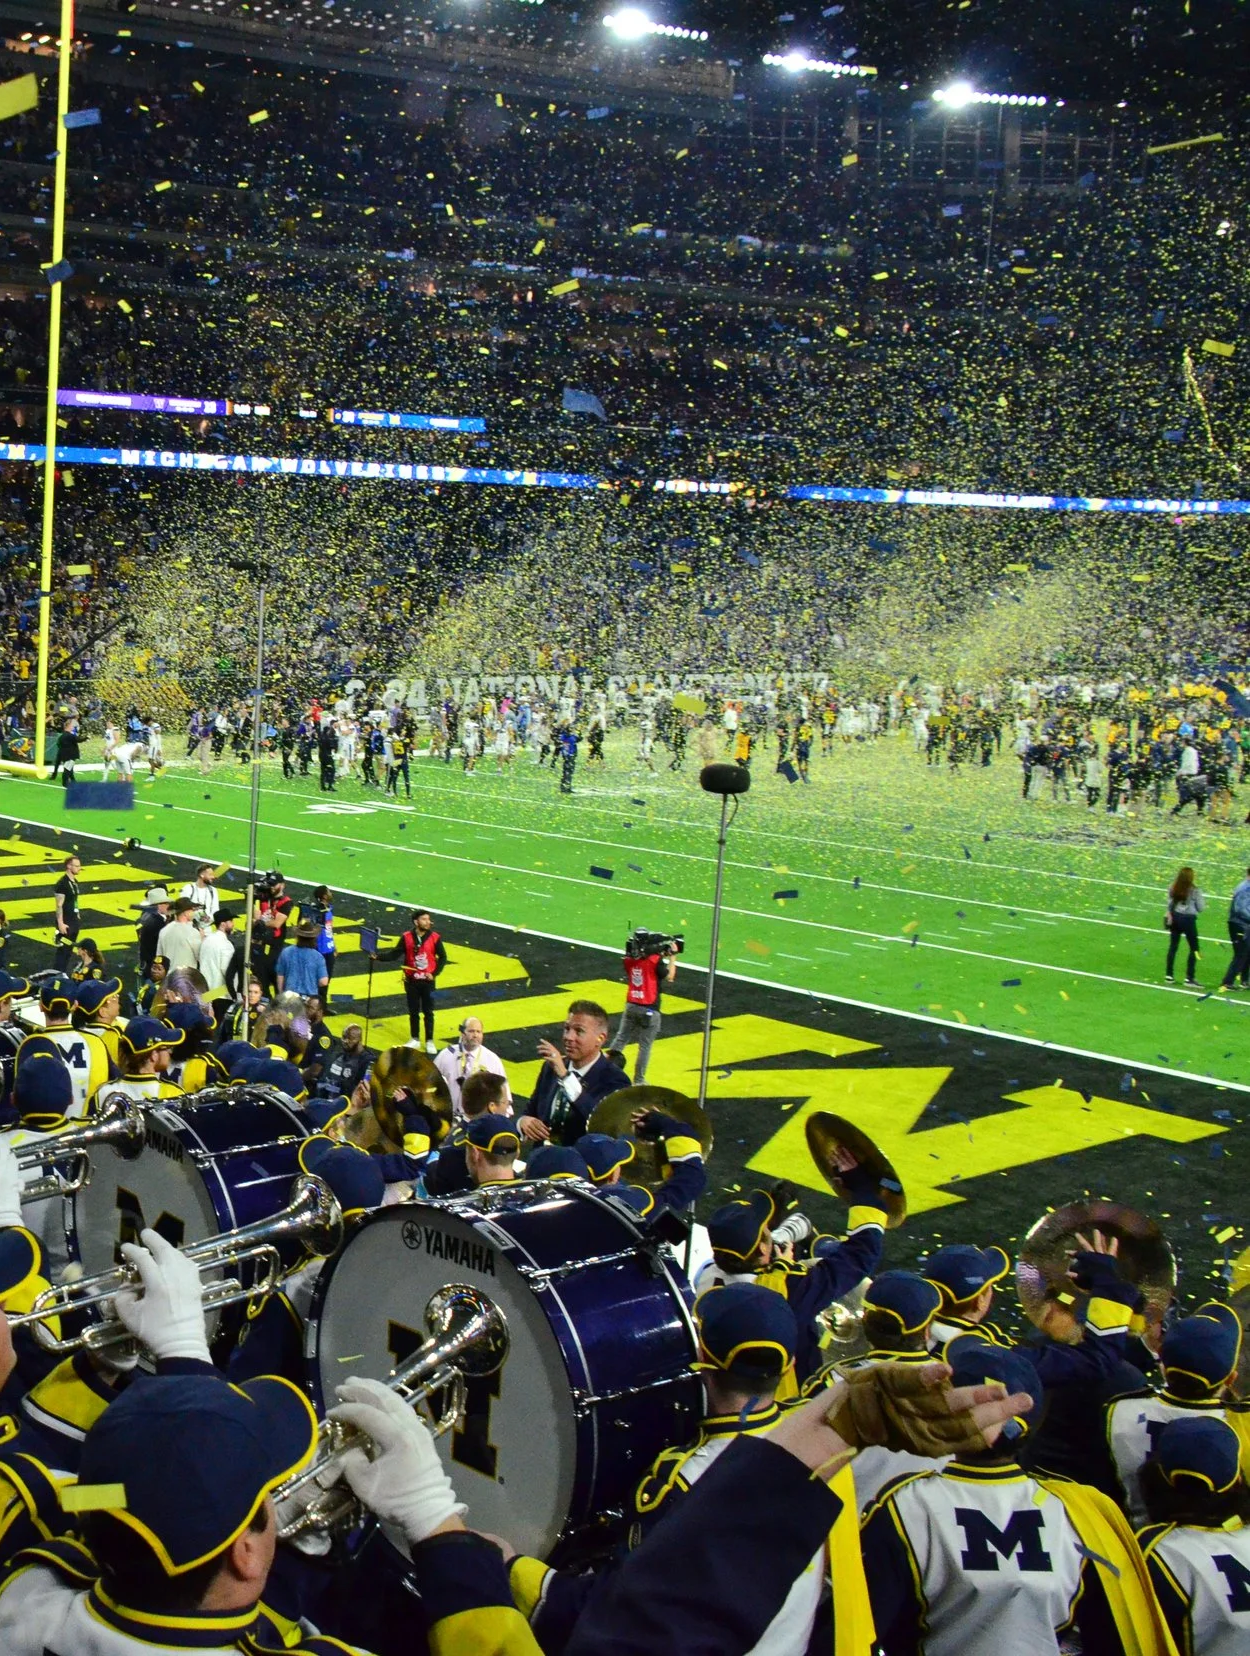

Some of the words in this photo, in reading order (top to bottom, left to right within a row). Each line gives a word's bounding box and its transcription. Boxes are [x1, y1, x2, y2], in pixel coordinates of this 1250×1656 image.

[57, 1042, 87, 1069] M
[146, 1127, 184, 1164] AMAHA
[423, 1226, 496, 1277] YAMAHA
[955, 1507, 1054, 1572] M
